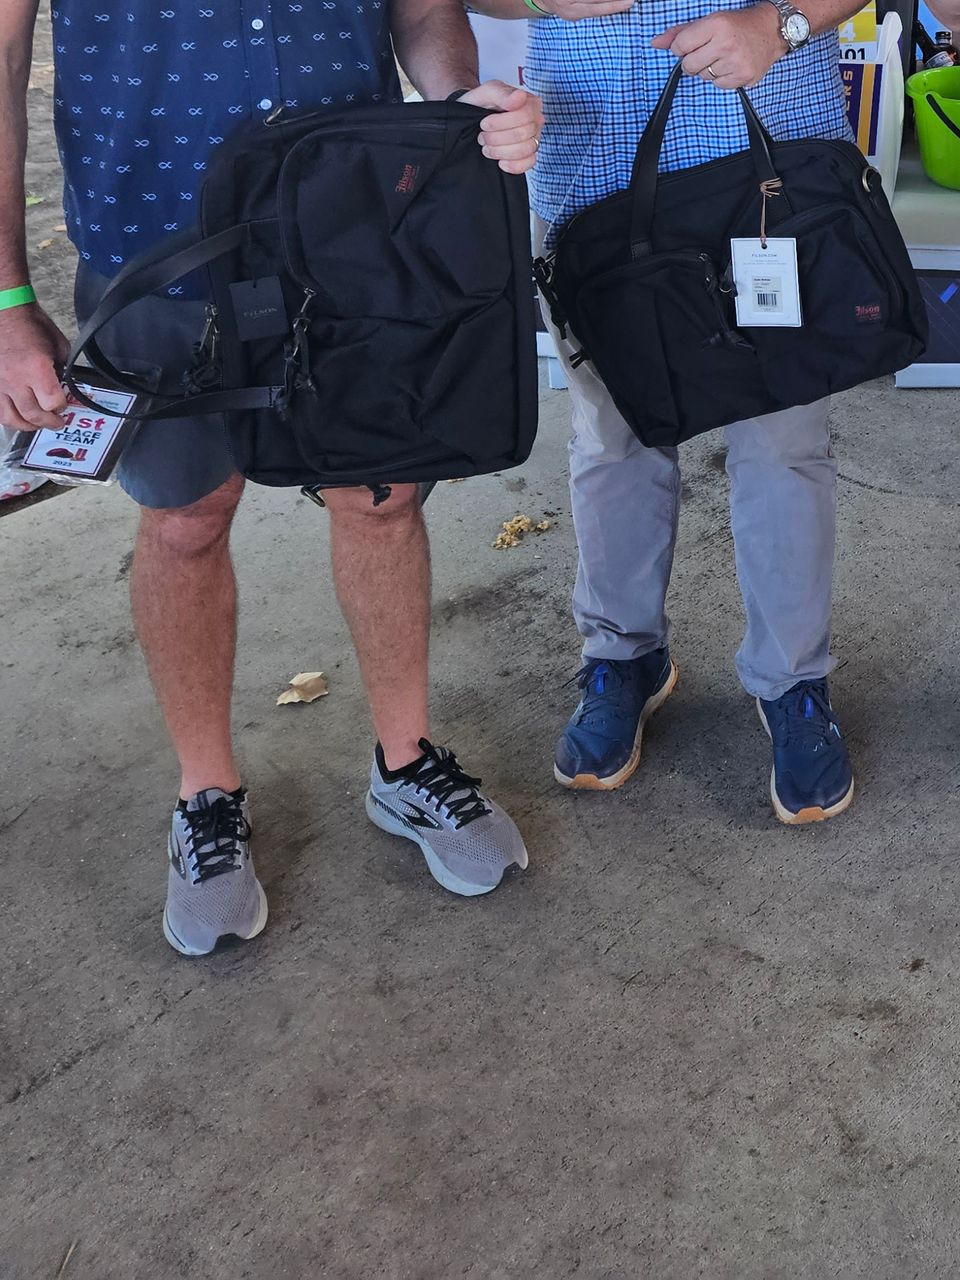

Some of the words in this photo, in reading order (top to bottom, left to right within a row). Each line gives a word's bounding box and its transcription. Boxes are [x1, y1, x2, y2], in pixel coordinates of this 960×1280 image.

[63, 412, 106, 431] 1st
[55, 433, 95, 445] TEAM
[63, 427, 101, 439] LACE
